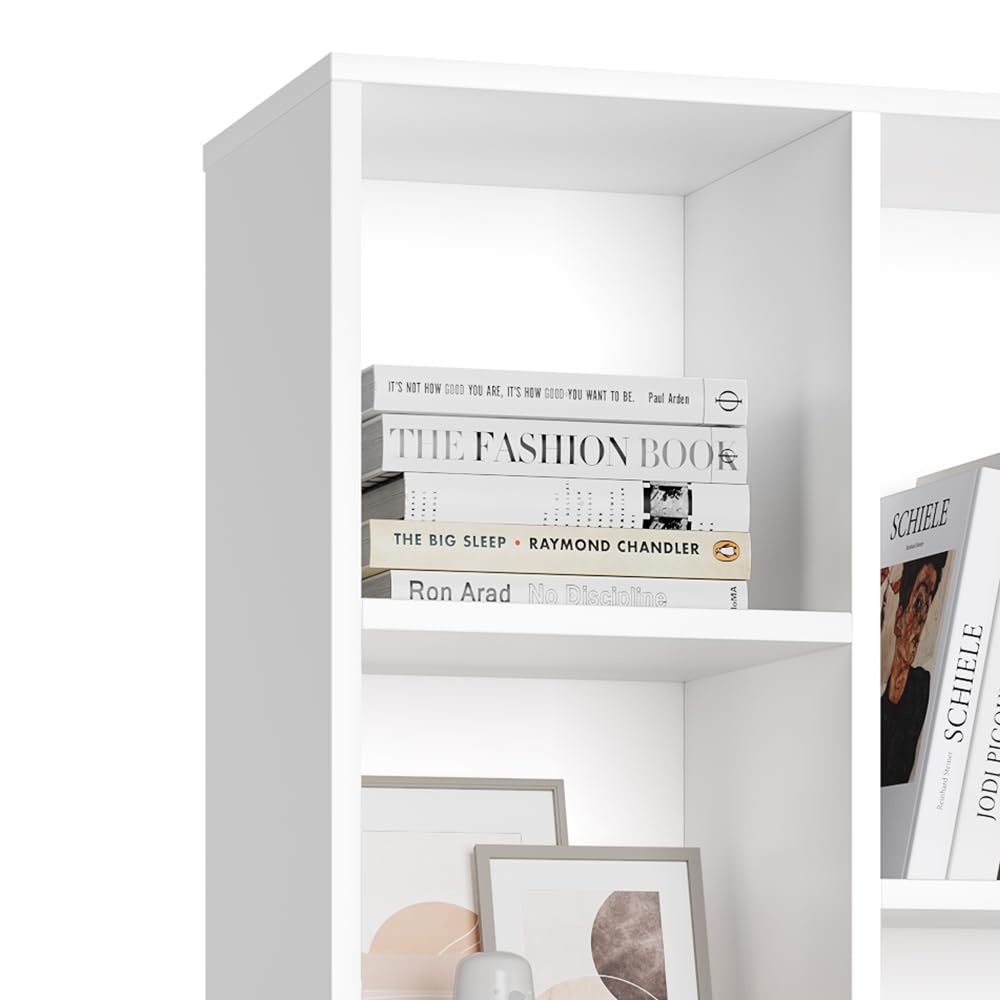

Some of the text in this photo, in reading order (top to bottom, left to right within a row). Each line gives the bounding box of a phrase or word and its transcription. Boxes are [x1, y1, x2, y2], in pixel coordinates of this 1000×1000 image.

[388, 381, 402, 392] IT'S
[407, 382, 420, 393] NOT
[425, 383, 441, 394] HOW
[445, 384, 464, 395] GOOD
[468, 385, 483, 396] YOU
[487, 386, 503, 398] ARE,
[507, 386, 521, 397] IT'S
[525, 387, 541, 398] HOW
[568, 389, 582, 400] YOU
[587, 390, 607, 401] WANT
[611, 391, 620, 402] TO
[623, 391, 635, 403] BE.
[649, 392, 689, 405] Paul Arden
[389, 428, 739, 471] THE FASHION BOOK
[889, 498, 950, 540] SCHIELE
[394, 533, 506, 548] THE BIG SLEEP
[529, 537, 699, 554] RAYMOND CHANDLER
[410, 580, 668, 607] Ron Arad No Discipline
[943, 624, 983, 743] SCHIELE
